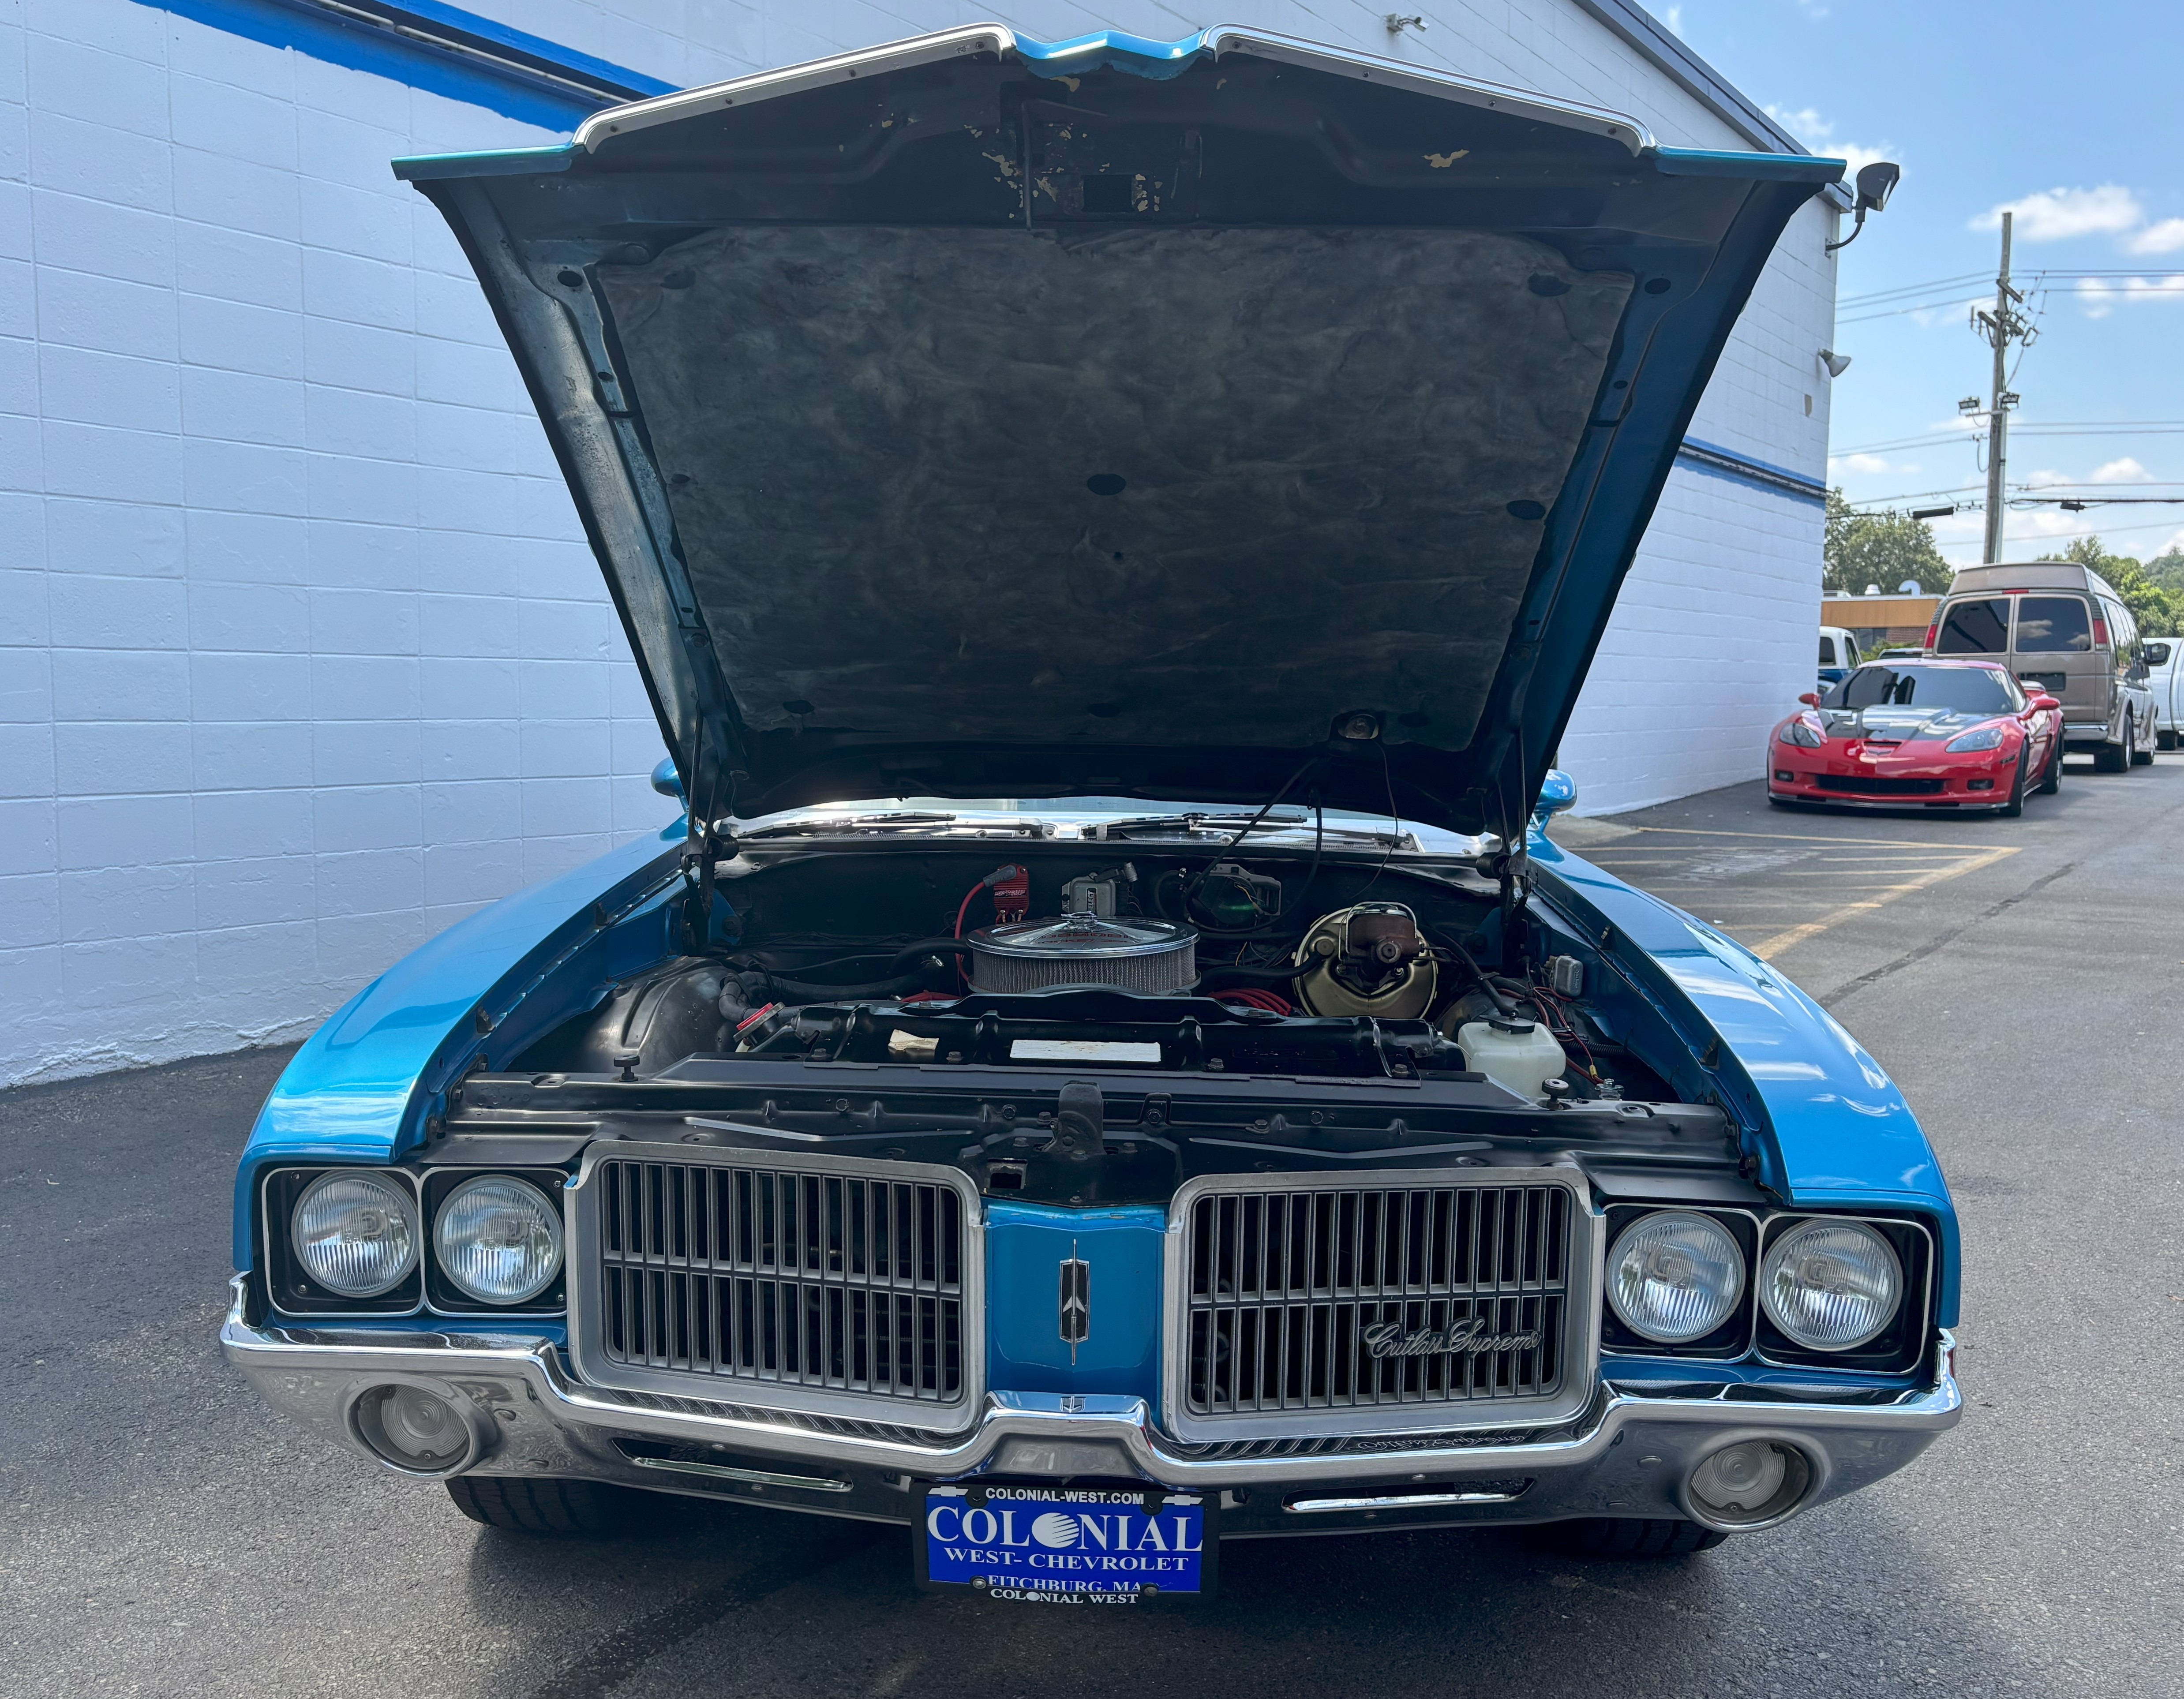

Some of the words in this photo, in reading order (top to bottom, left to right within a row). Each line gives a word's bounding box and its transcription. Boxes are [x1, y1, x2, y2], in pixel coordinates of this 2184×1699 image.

[1364, 1323, 1443, 1358] Cutlass
[1443, 1318, 1542, 1358] Supreme
[985, 1488, 1144, 1504] COLONIAL-WEST.COM
[928, 1506, 1203, 1551] COLONIAL
[1029, 1554, 1189, 1570] CHEVROLET
[1113, 1582, 1140, 1591] MA
[990, 1589, 1083, 1603] COLONIAL
[1089, 1594, 1139, 1604] WEST
